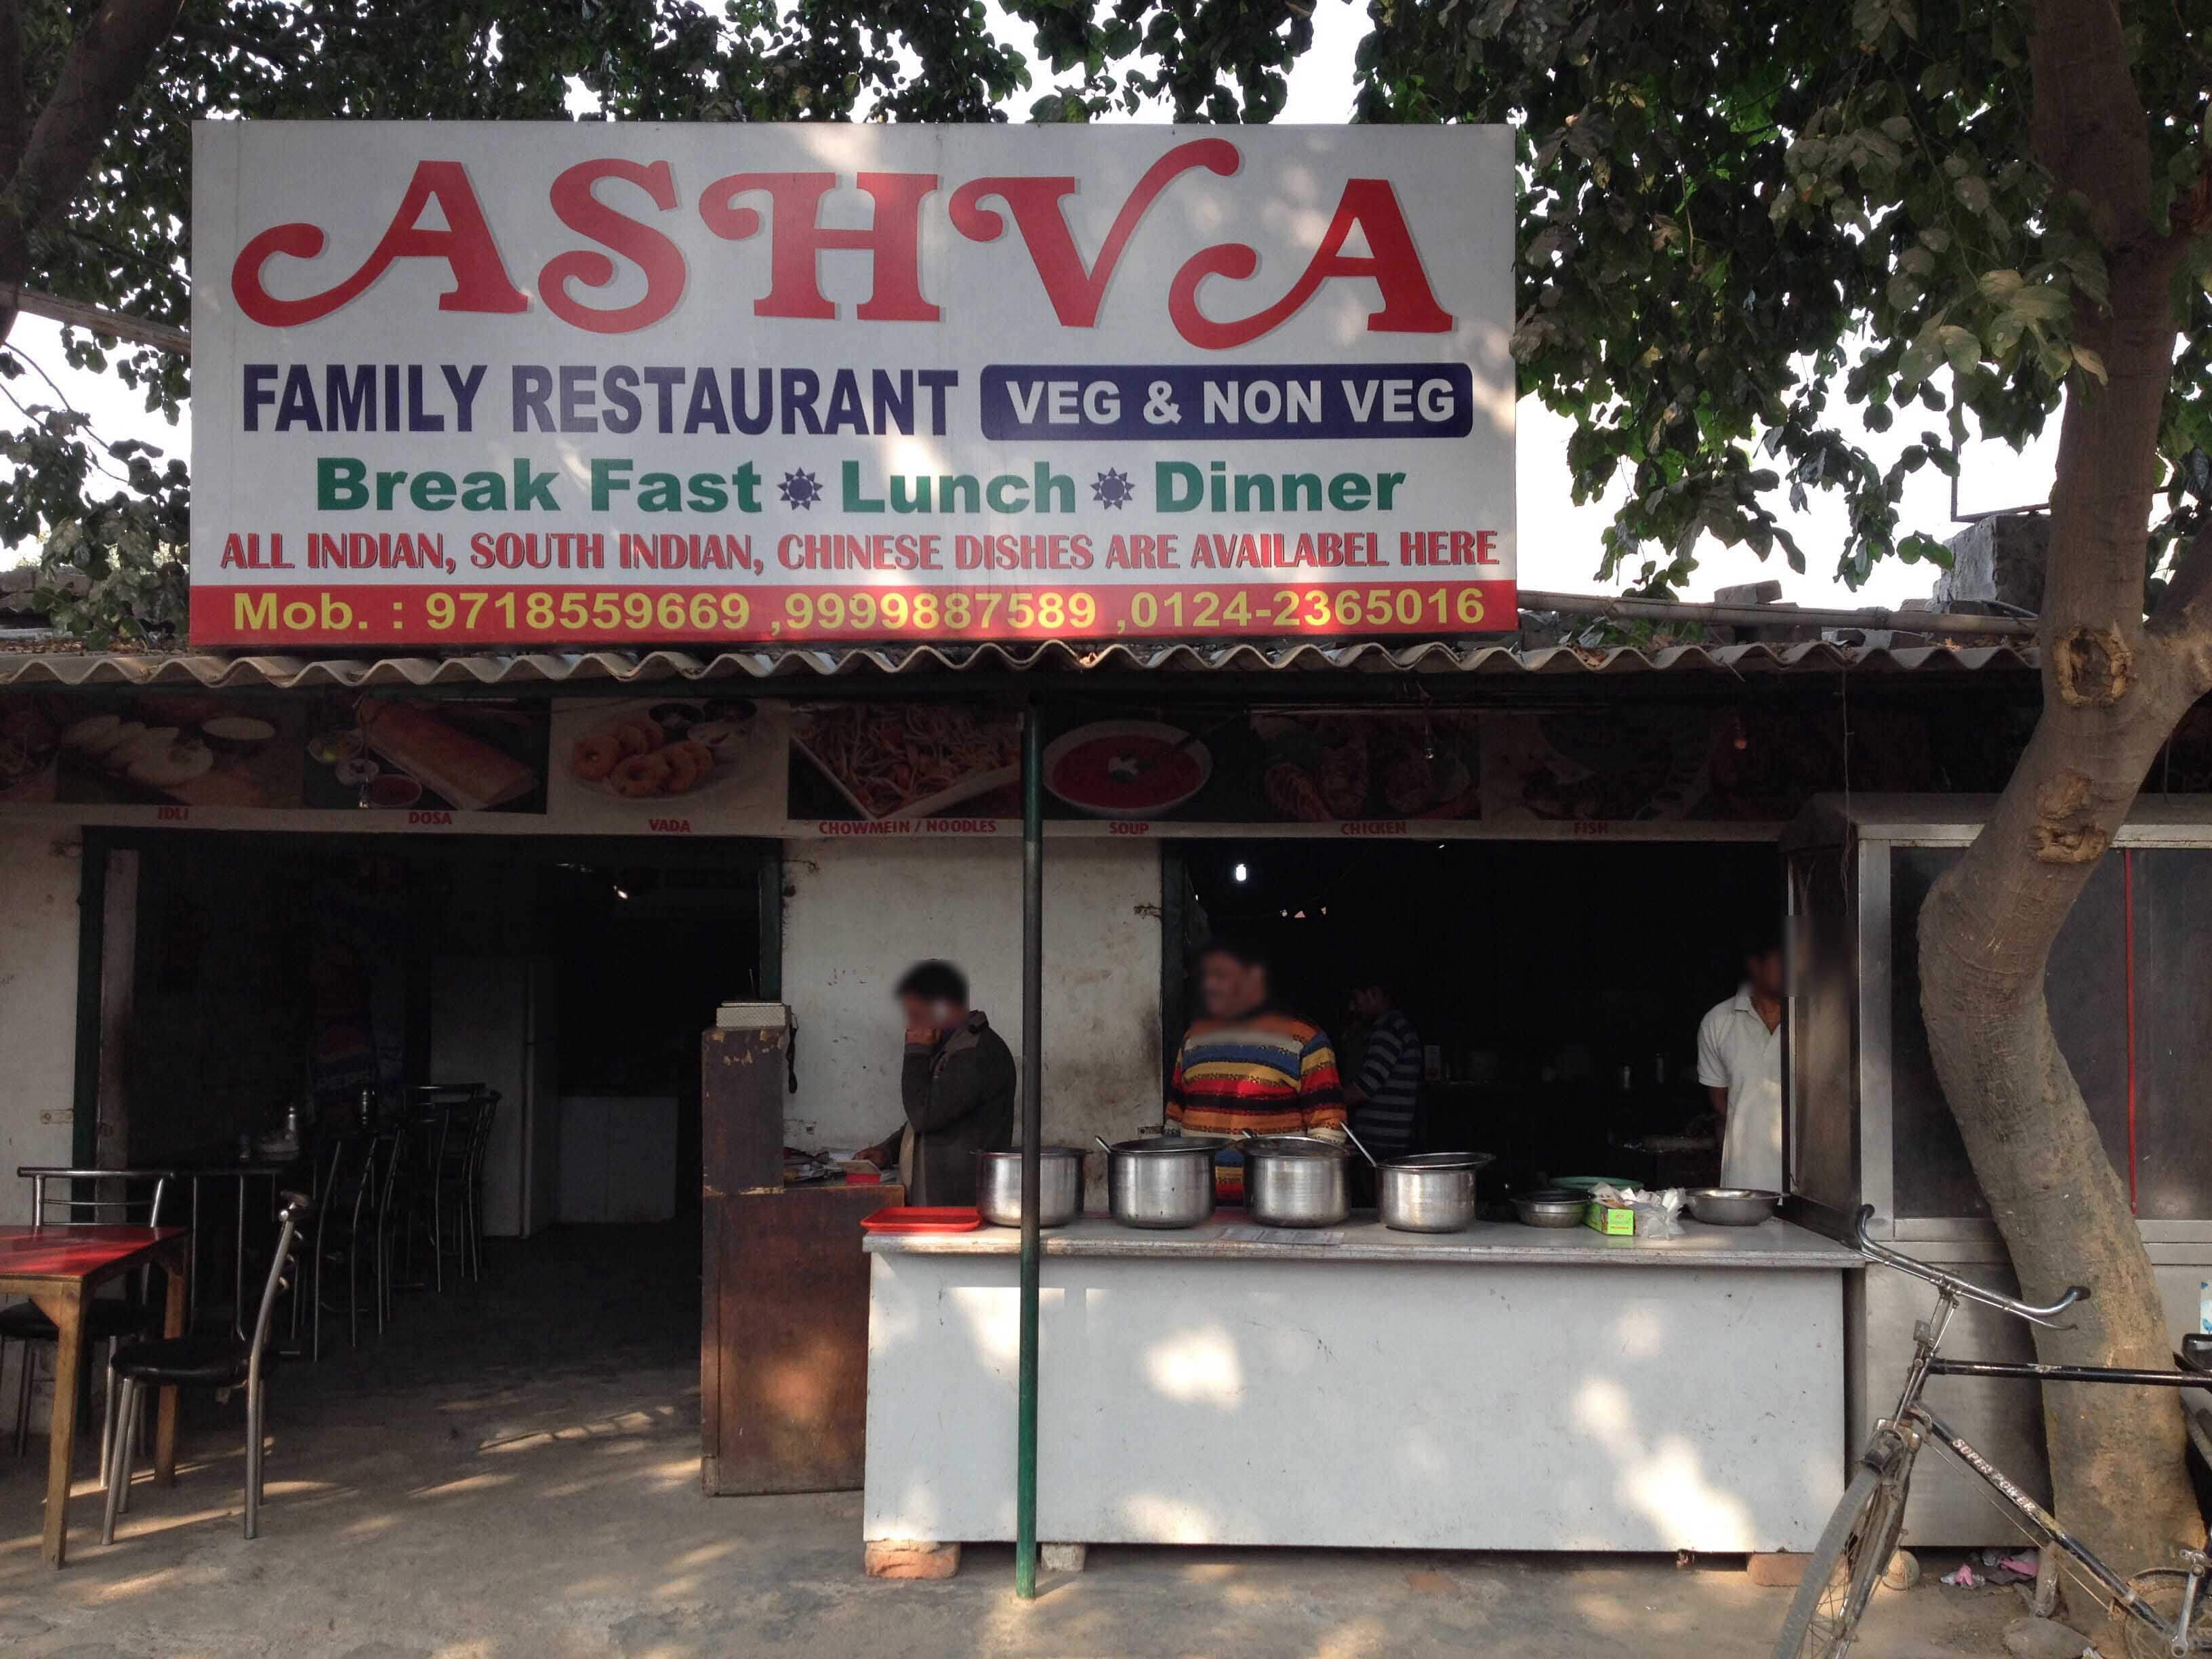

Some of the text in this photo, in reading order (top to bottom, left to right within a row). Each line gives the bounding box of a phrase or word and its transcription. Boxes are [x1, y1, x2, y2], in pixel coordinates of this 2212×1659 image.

[231, 137, 1455, 350] ASHVA
[243, 364, 959, 435] FAMILY RESTAURANT
[1004, 378, 1455, 425] VEG & NON VEG
[316, 457, 1406, 513] Break Fast Lunch Dinner
[220, 530, 1500, 576] ALL INDIAN, SOUTH INDIAN, CHINESE DISHES ARE AVAILABEL HERE
[233, 592, 368, 631] Mob.
[426, 592, 750, 630] 9718559669
[157, 807, 189, 820] IDLI
[409, 811, 452, 825] DOSA
[649, 818, 691, 833] VADA
[819, 821, 911, 835] CHOWMEIN
[926, 819, 997, 833] NOODLES
[1109, 822, 1149, 836] SOUP
[1340, 821, 1407, 836] CHICKEN
[1573, 822, 1609, 835] FISH
[1952, 1438, 2036, 1513] SUPER POWER
